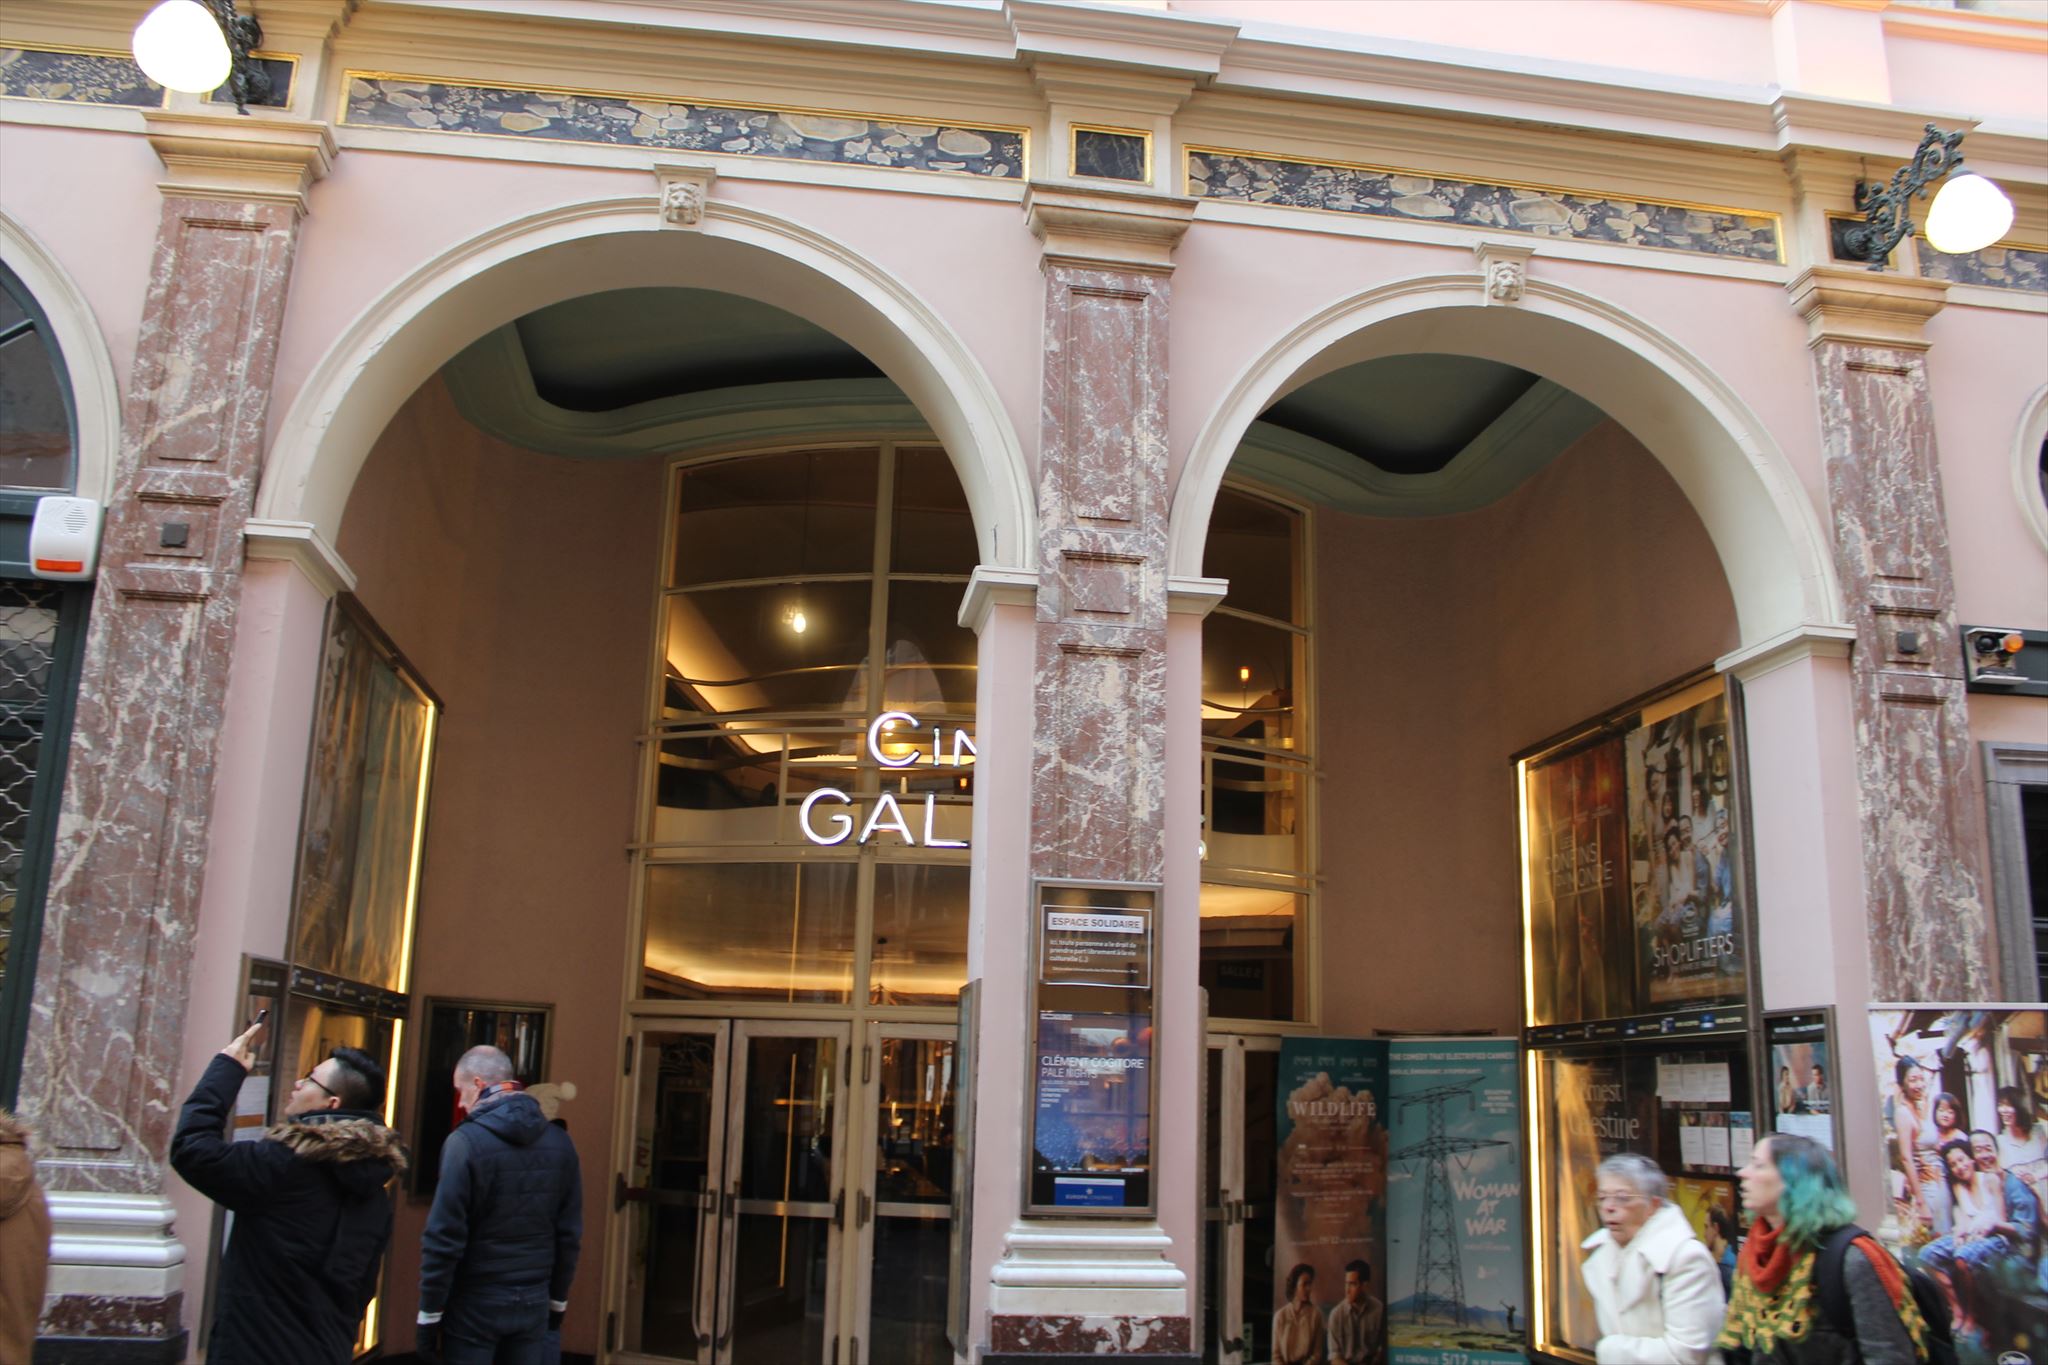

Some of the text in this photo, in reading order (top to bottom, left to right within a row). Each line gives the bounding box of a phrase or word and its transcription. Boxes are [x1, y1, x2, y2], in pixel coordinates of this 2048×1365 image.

[799, 786, 971, 848] GAL
[1051, 917, 1141, 929] ESPACE SOLIDAIRE
[1653, 933, 1734, 968] SHOPLIFTERS
[1041, 1054, 1145, 1069] CLÉMENT COGITORE
[1041, 1067, 1098, 1079] PALE NIGHTS
[1293, 1101, 1377, 1117] WILDLIFE
[1464, 1215, 1507, 1236] WAR
